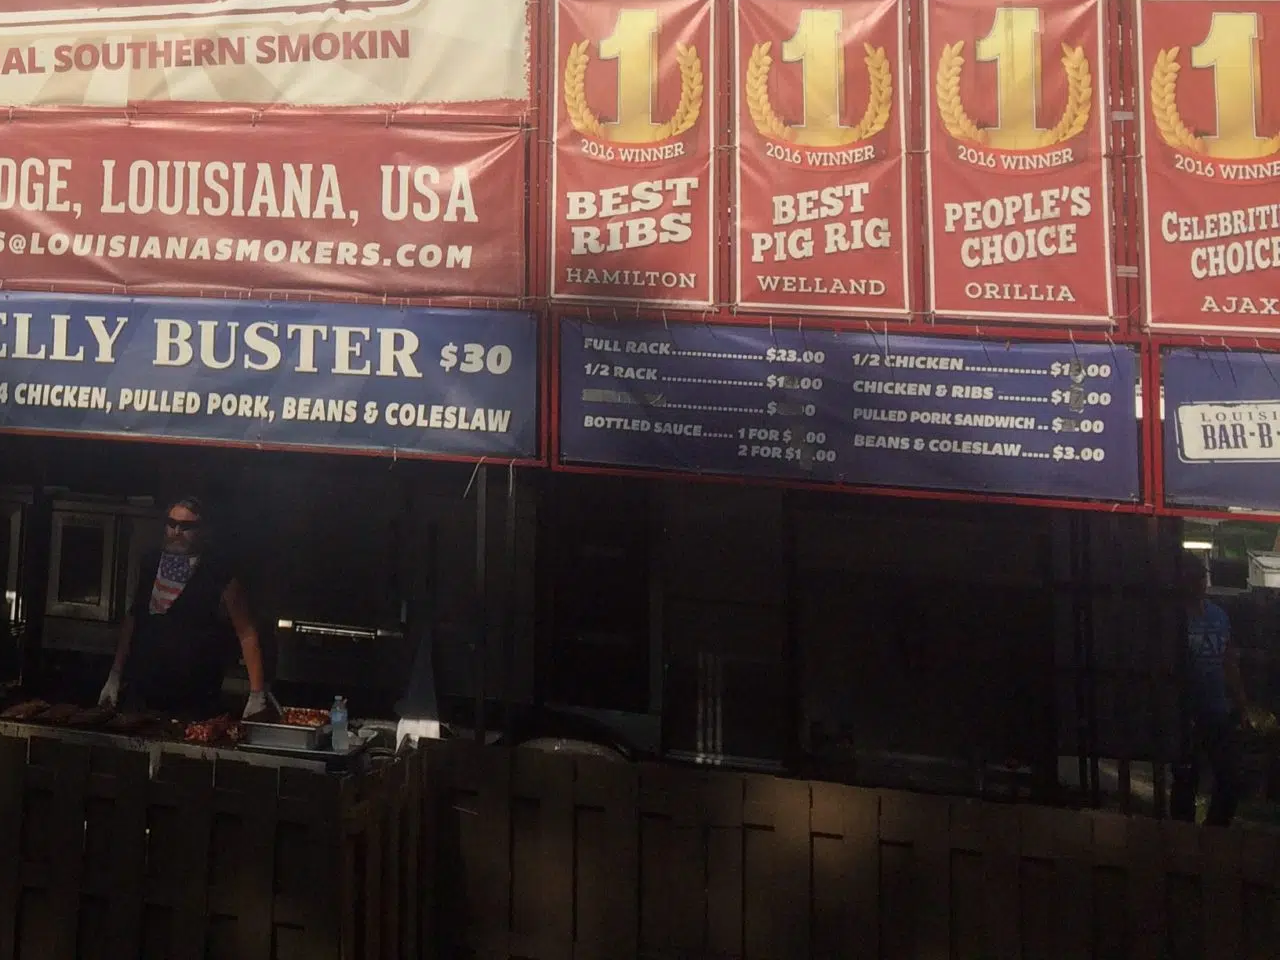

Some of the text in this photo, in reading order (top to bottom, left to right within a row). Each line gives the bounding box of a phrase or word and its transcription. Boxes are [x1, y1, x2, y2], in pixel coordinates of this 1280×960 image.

[53, 37, 247, 73] SOUTHERN
[255, 30, 410, 64] SMOKIN
[101, 158, 359, 227] LOUISIANA,
[380, 164, 479, 224] USA
[772, 182, 869, 225] BEST
[943, 185, 1092, 232] PEOPLE'S
[752, 218, 892, 264] PIG RIG
[961, 223, 1078, 270] CHOICE
[566, 267, 697, 289] HAMILTON
[758, 275, 886, 296] WELLAND
[965, 283, 1075, 304] ORILLIA
[152, 318, 423, 379] BUSTER
[440, 343, 511, 374] $30
[585, 338, 825, 364] FULL RACK $23.00
[14, 383, 112, 413] CHICKEN,
[119, 388, 201, 413] PULLED
[207, 392, 276, 420] PORK,
[282, 398, 358, 423] BEANS
[365, 401, 379, 424] &
[385, 403, 511, 433] COLESLAW
[853, 408, 1035, 429] PULLED PORK SANDWICH
[929, 439, 1104, 462] COLESLAW $3.00
